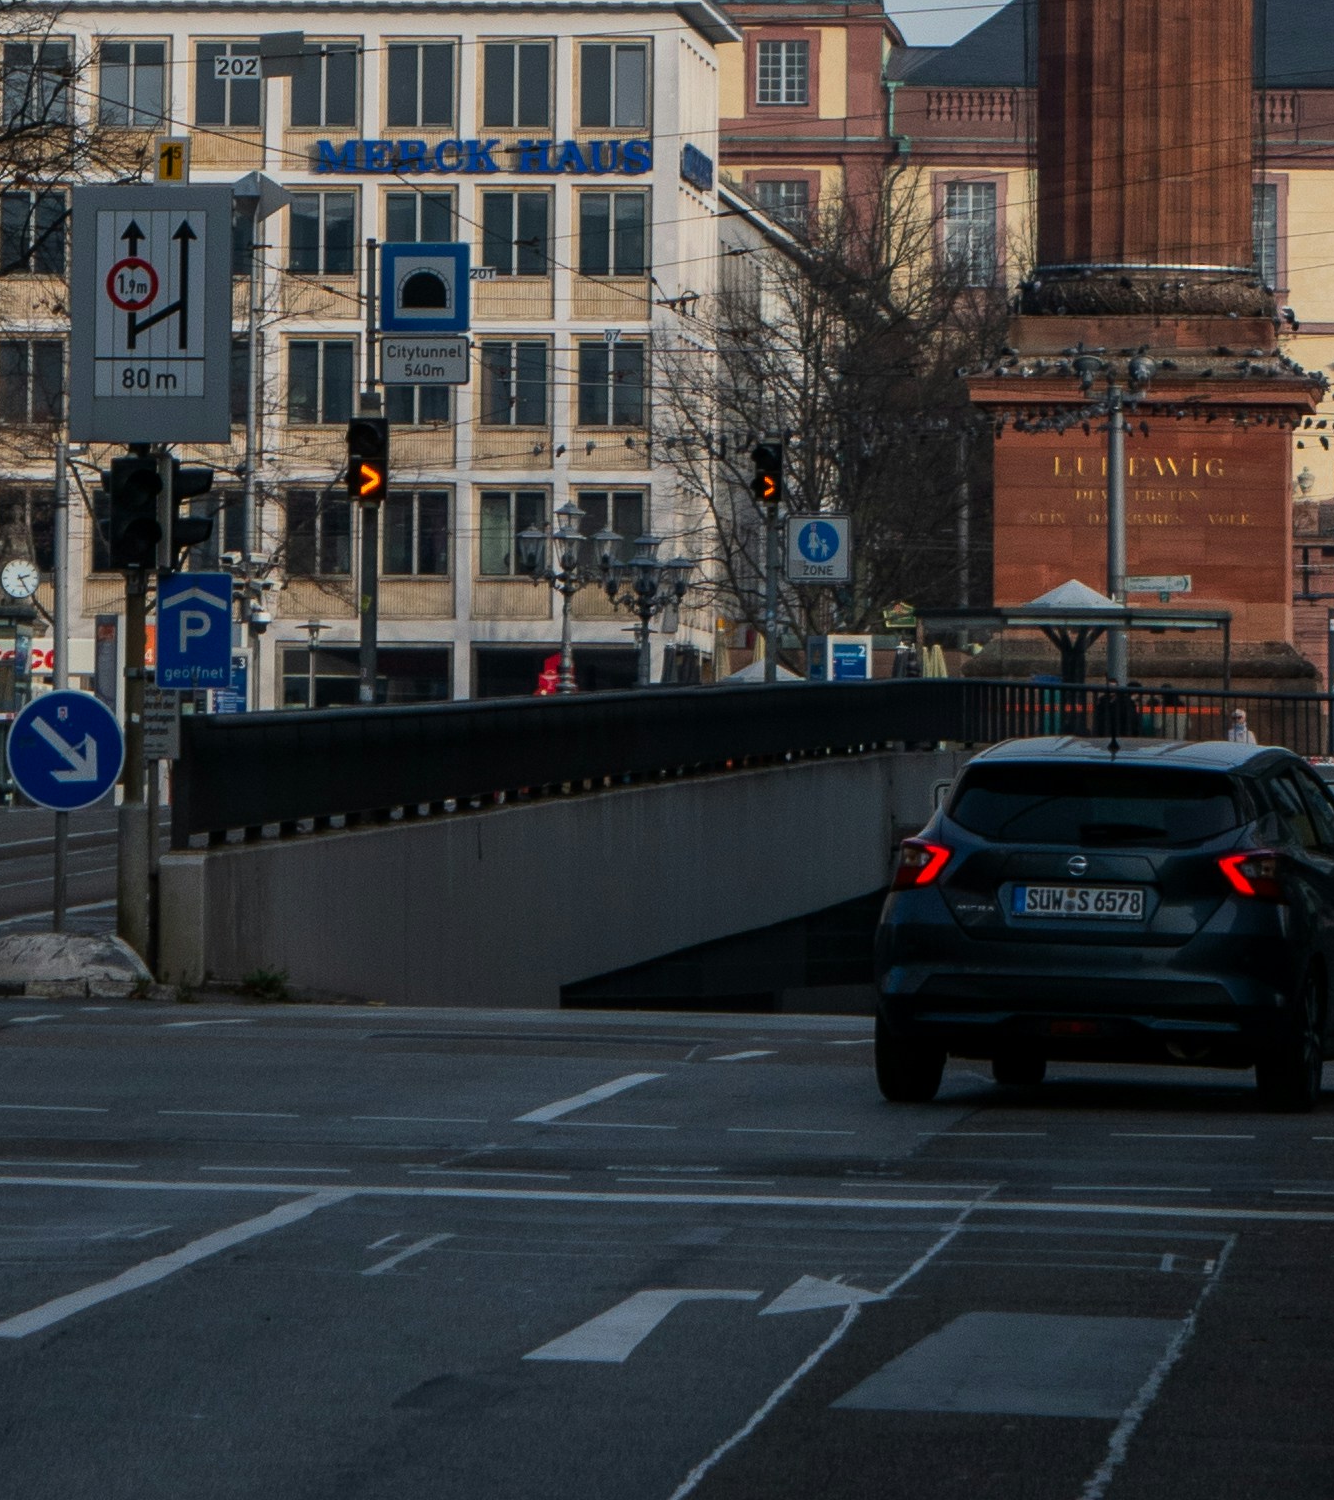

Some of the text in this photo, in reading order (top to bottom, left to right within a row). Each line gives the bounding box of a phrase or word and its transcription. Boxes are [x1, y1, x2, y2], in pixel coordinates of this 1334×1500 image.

[216, 59, 258, 76] 202
[317, 140, 501, 173] MERCK
[519, 139, 651, 173] HAUS
[387, 344, 461, 360] Citytunnel
[122, 368, 177, 389] 80 m
[404, 363, 445, 378] 540m
[803, 565, 834, 575] ZONE
[179, 610, 212, 652] P
[165, 665, 224, 681] geöffnet
[1027, 889, 1141, 914] SÜW S 6578
